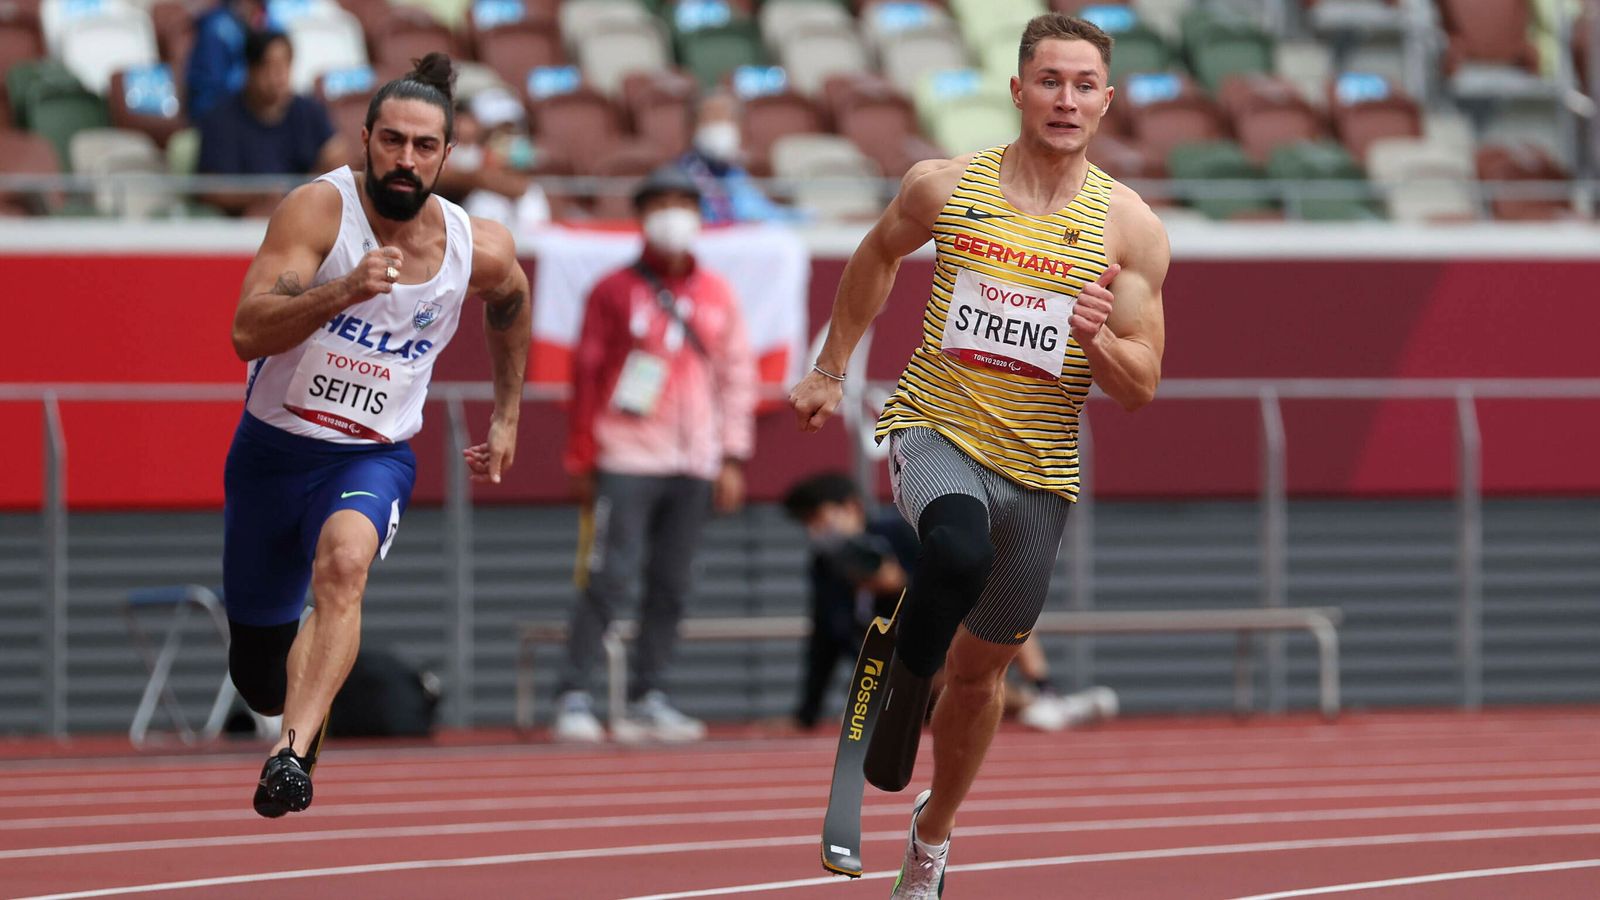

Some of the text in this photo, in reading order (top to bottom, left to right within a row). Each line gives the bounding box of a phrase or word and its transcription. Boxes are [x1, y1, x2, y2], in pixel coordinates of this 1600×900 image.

[953, 233, 1075, 278] GERMANY
[979, 283, 1047, 311] TOYOTA
[955, 305, 1058, 352] STRENG
[326, 352, 391, 381] TOYOTA
[973, 353, 1007, 368] TOKYO 2020
[308, 374, 388, 415] SEITIS
[317, 413, 348, 430] TOKYO 2020
[849, 676, 878, 741] ÖSSUR
